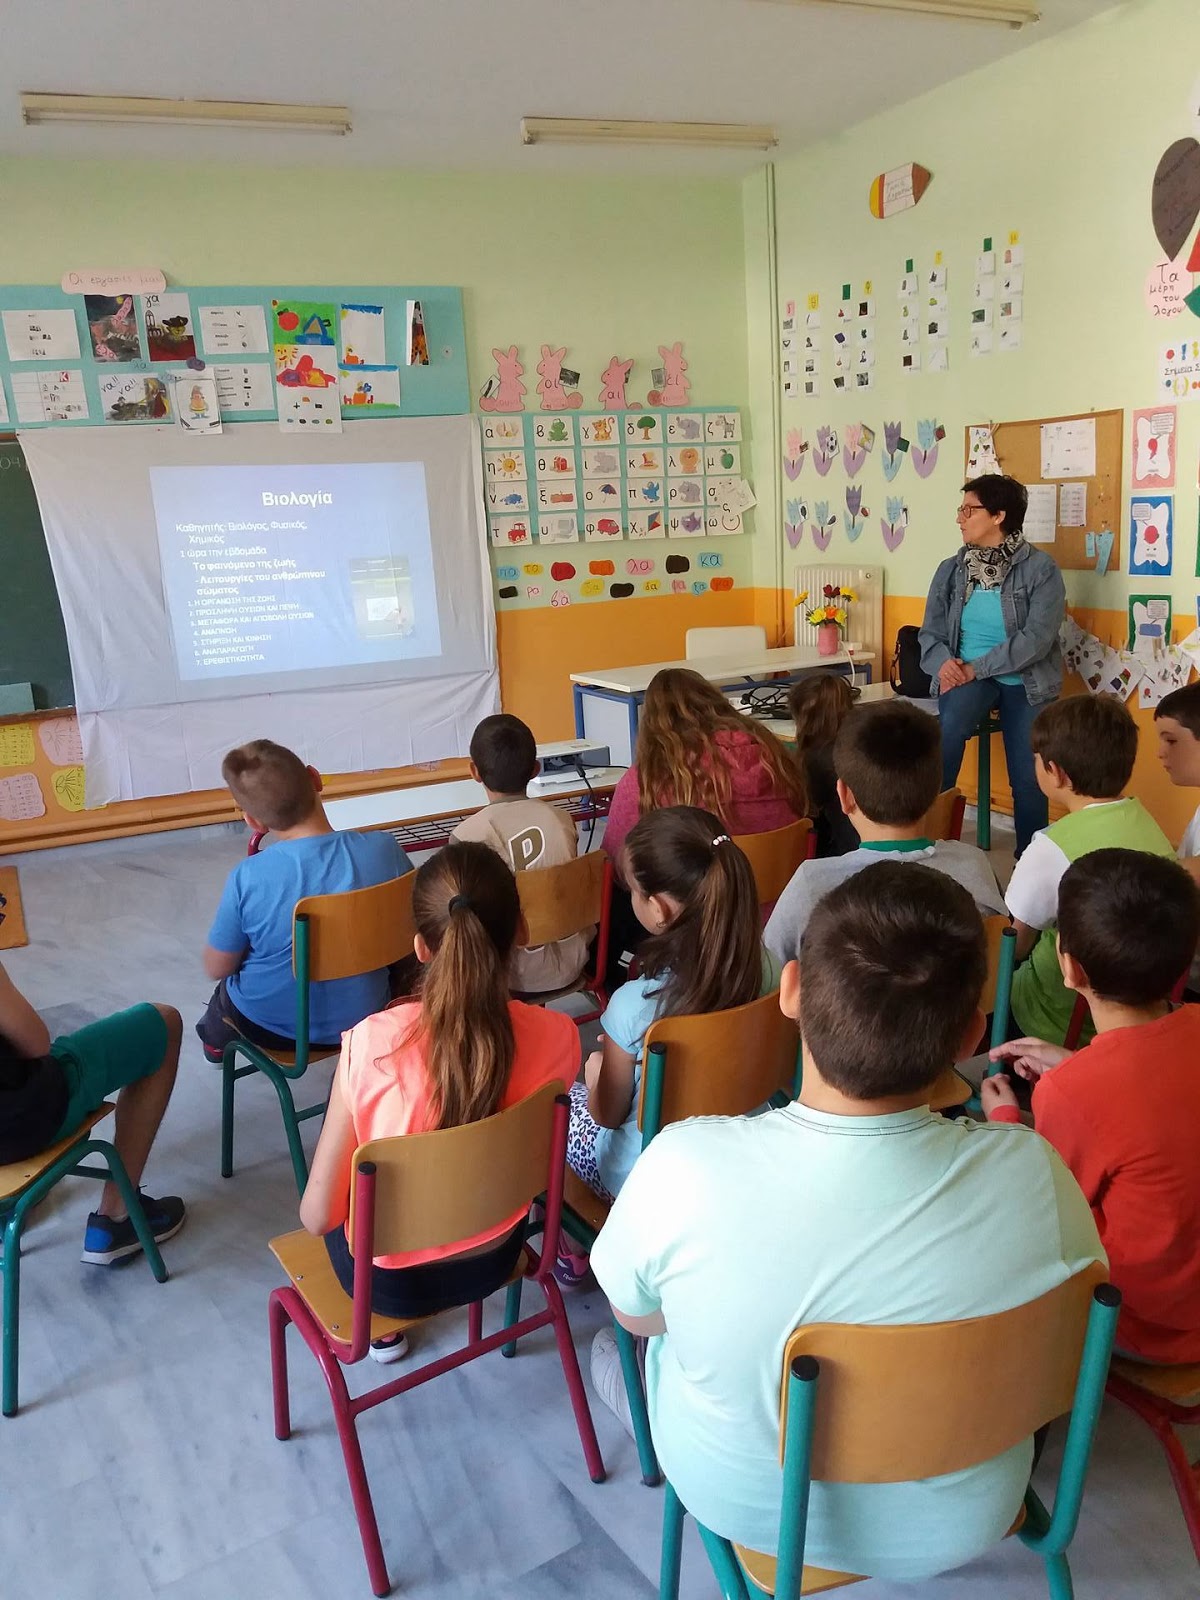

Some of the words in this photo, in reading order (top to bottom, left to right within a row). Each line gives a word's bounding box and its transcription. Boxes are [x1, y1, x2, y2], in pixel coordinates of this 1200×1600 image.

[1156, 263, 1180, 284] Τα
[262, 489, 333, 508] Βιολογία
[188, 534, 225, 545] Χημικός
[224, 546, 267, 557] εβδομάδα
[193, 562, 206, 571] Το
[207, 560, 256, 571] φαινόμενο
[257, 560, 272, 569] της
[273, 558, 297, 569] ζωής
[200, 574, 254, 585] Λειτουργίες
[254, 573, 271, 582] του
[271, 569, 326, 581] ανθρώπινου
[196, 586, 239, 597] σώματος
[203, 654, 265, 666] ΕΡΕΘΙΣΤΙΚΟΤΗΤΑ
